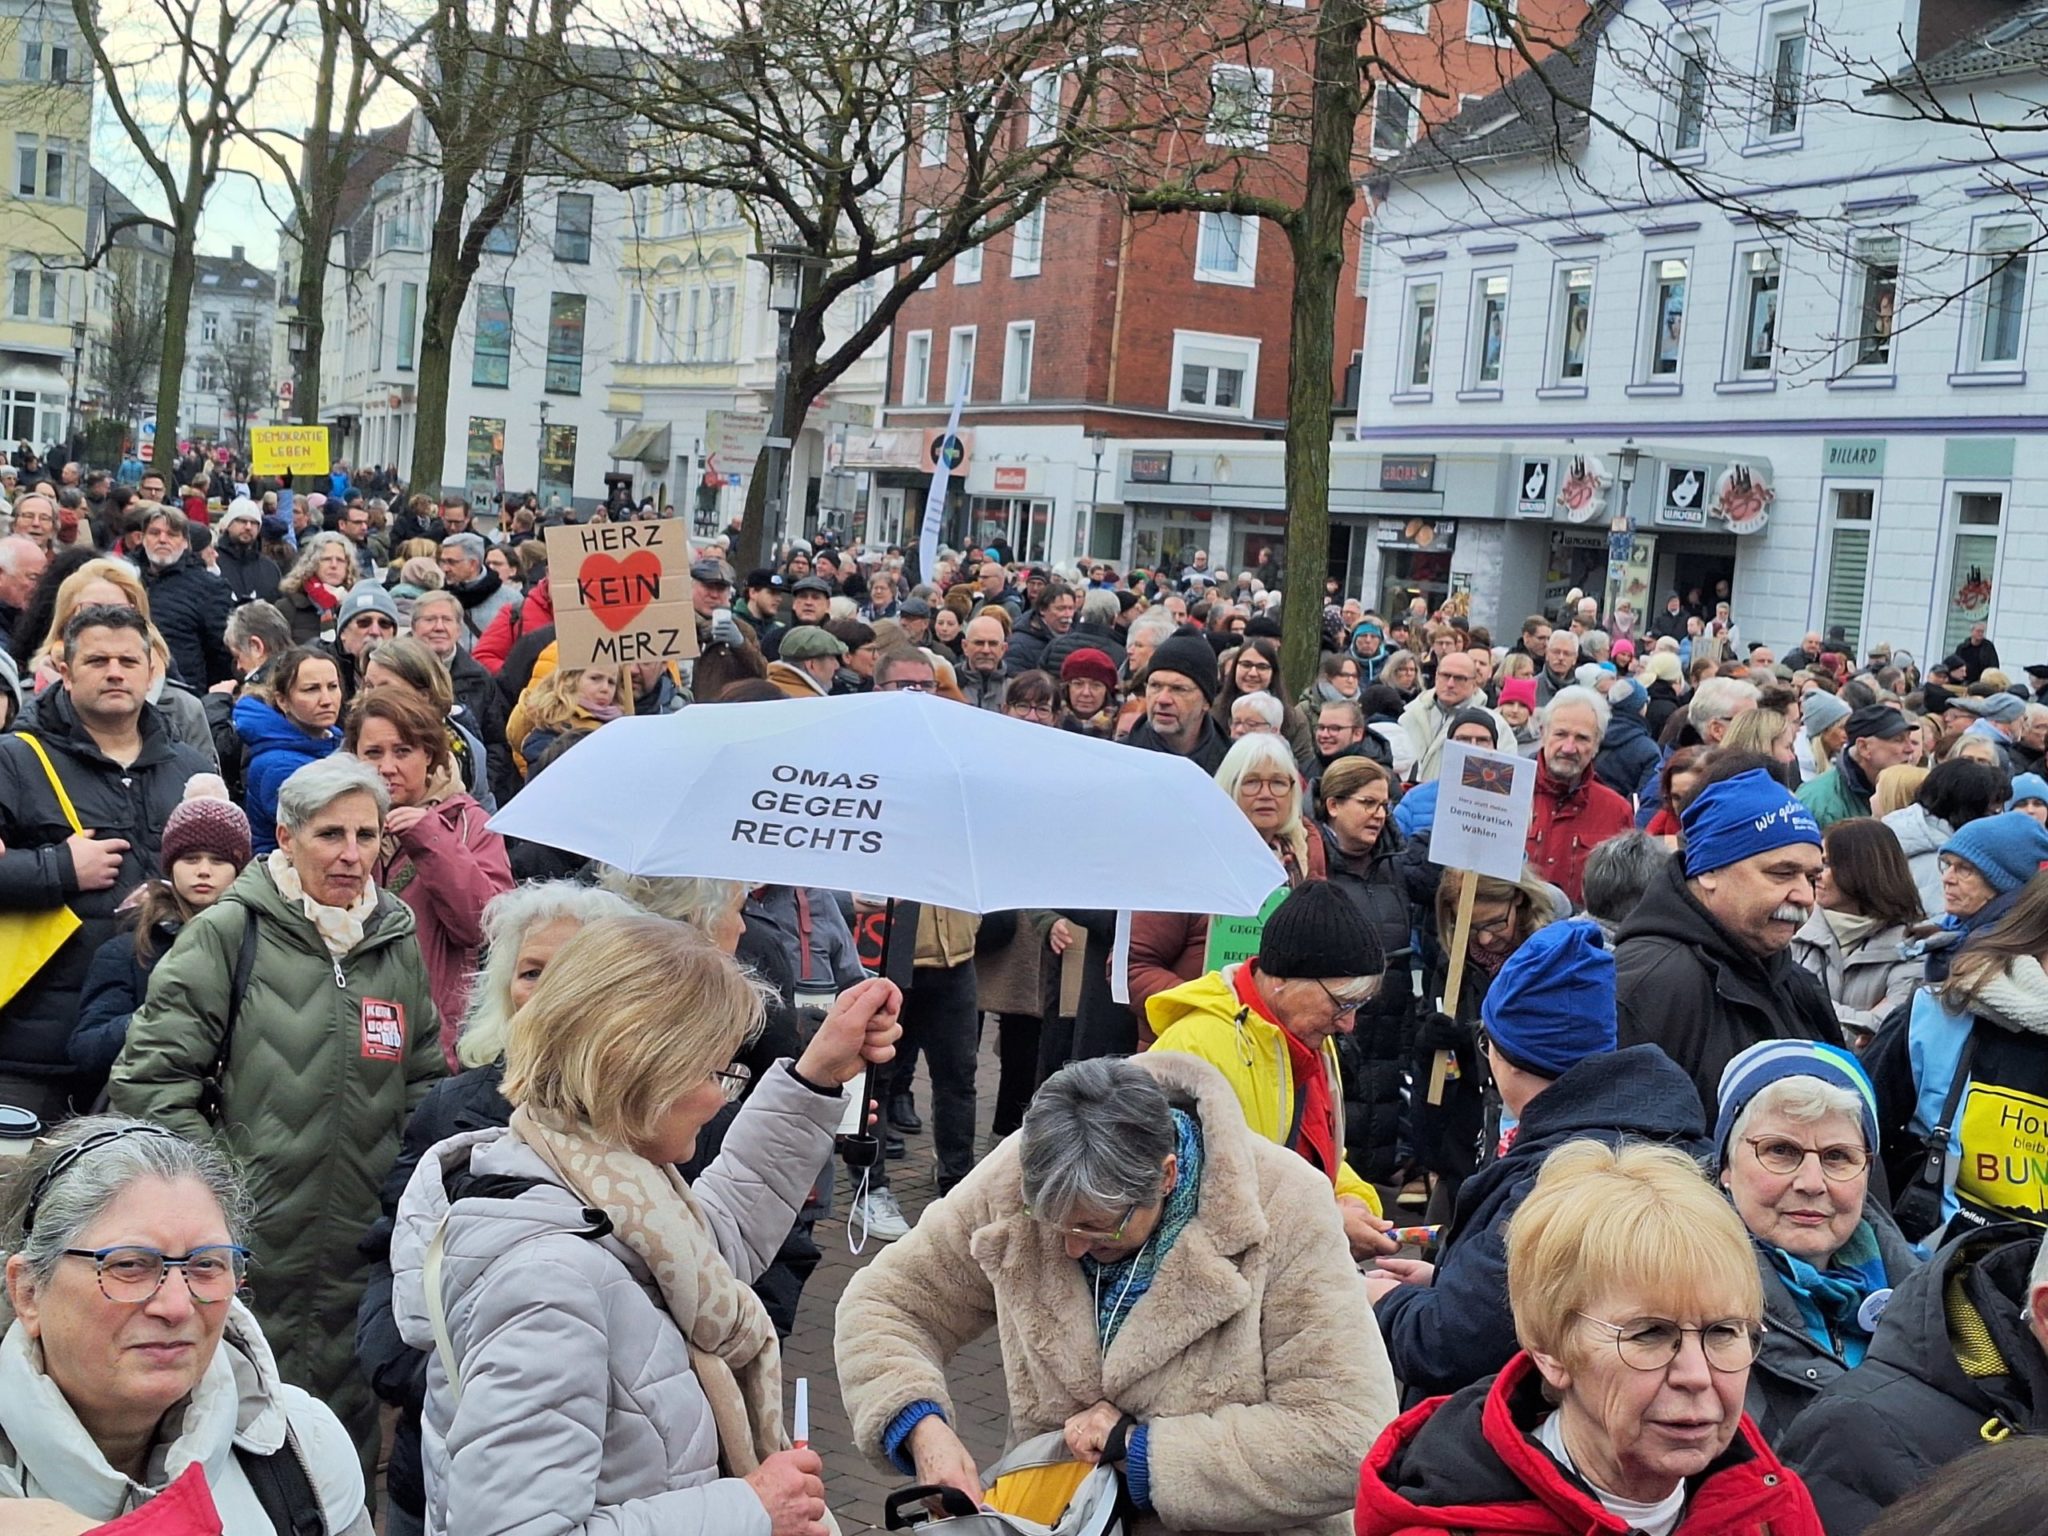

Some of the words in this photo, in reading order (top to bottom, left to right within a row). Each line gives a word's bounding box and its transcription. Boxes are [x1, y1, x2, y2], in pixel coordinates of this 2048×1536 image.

[256, 431, 323, 442] DEMOKRATIE
[270, 446, 311, 457] LEBEN
[1829, 448, 1876, 464] BILLARD
[581, 525, 663, 552] HERZ
[577, 573, 660, 606] KEIN
[591, 629, 681, 663] MERZ
[772, 765, 880, 790] OMAS
[751, 790, 883, 820] GEGEN
[1450, 805, 1513, 827] Demokratisch
[1462, 823, 1497, 838] Wählen
[1755, 811, 1776, 832] wir
[731, 819, 884, 854] RECHTS
